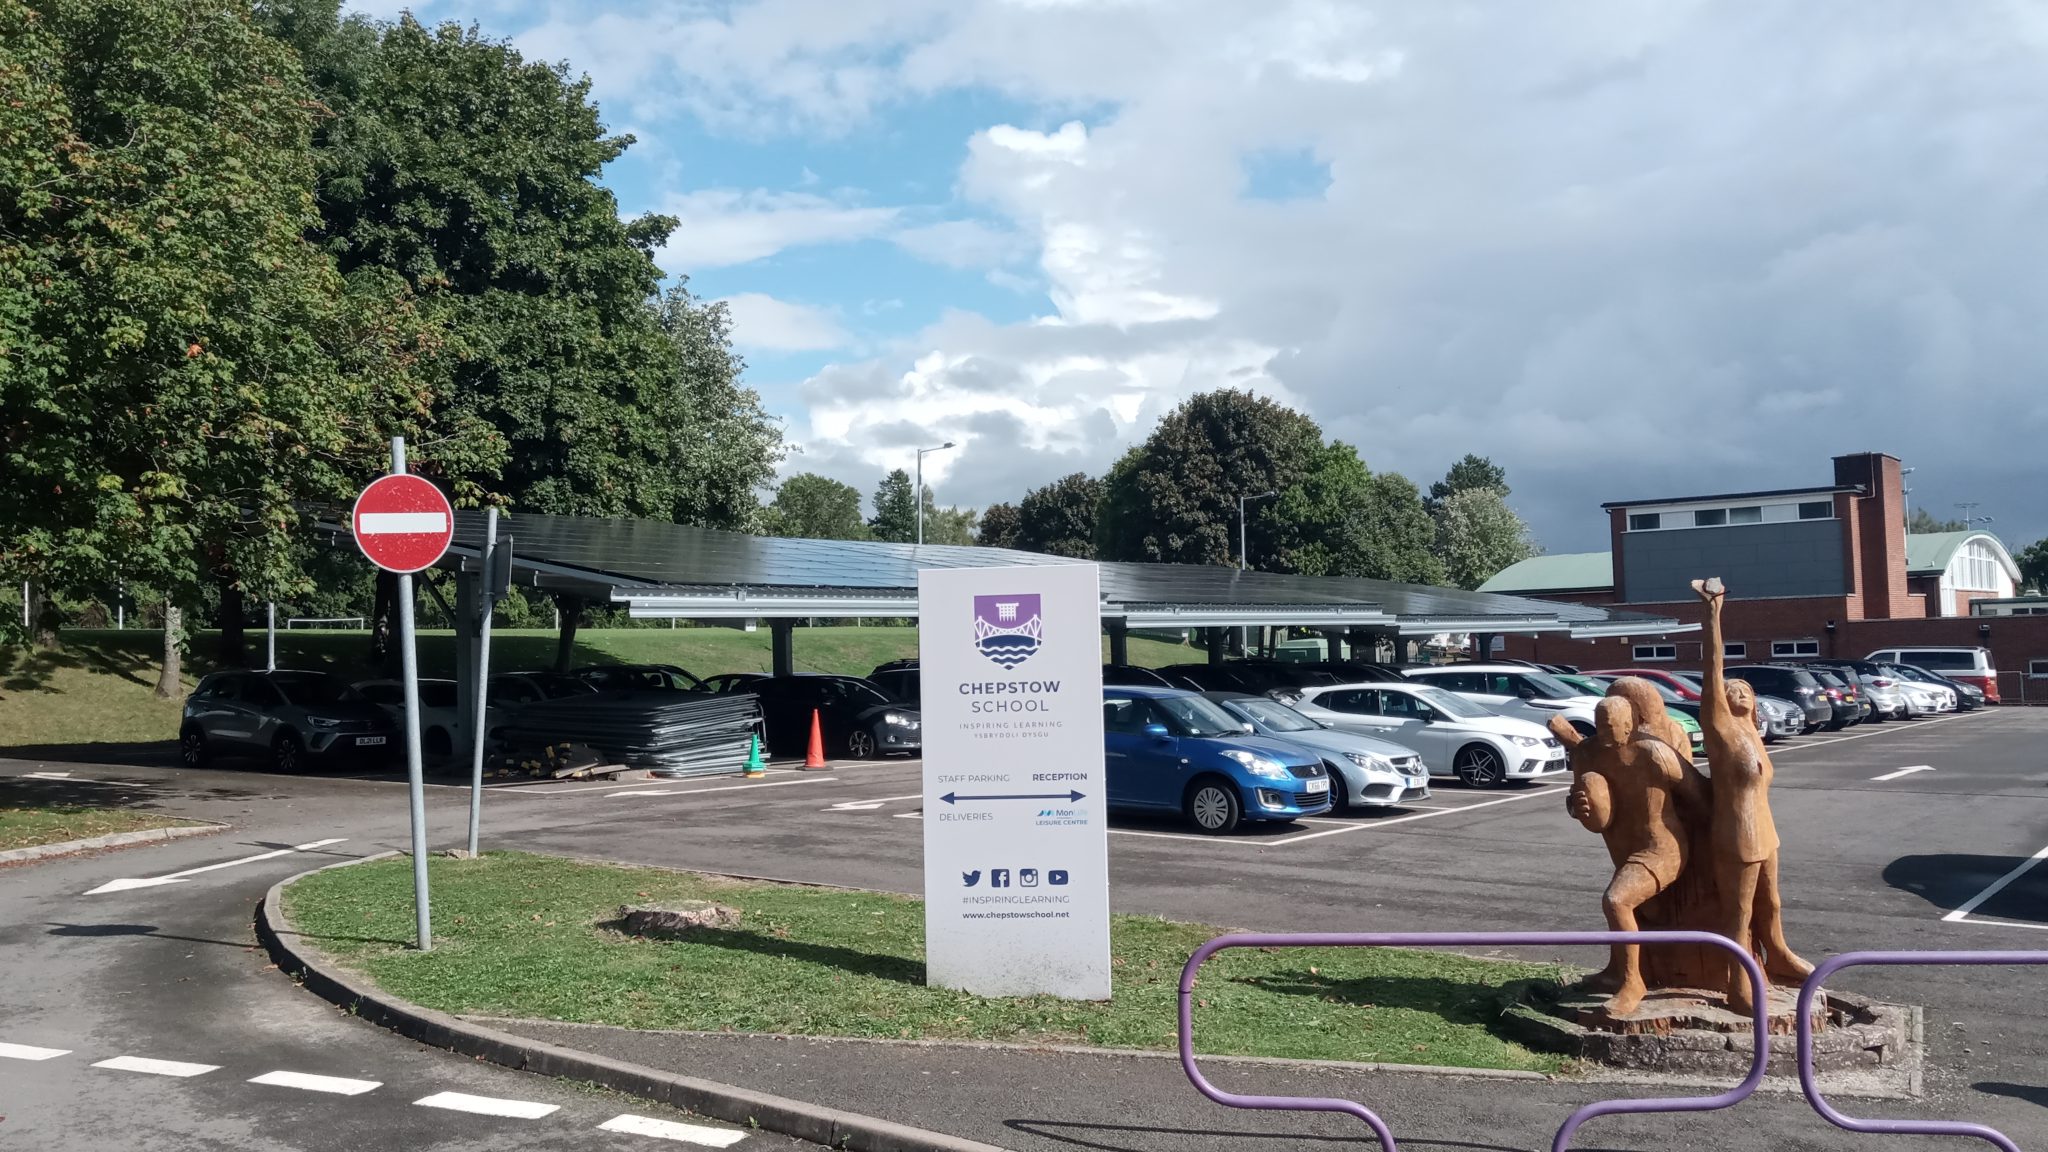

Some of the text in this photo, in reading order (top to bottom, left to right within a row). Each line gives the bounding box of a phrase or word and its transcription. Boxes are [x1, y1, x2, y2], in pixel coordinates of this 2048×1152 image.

[959, 680, 1061, 695] CHEPSTOW
[971, 699, 1049, 713] SCHOOL
[959, 721, 1063, 730] INSPIRING LEARNING
[937, 774, 1010, 783] STAFF PARKING
[1032, 772, 1088, 782] RECEPTION
[939, 812, 993, 822] DELIVERIES
[962, 895, 1070, 905] #INSPIRINGLEARNING
[962, 910, 1070, 920] www.chepstowschool.net
